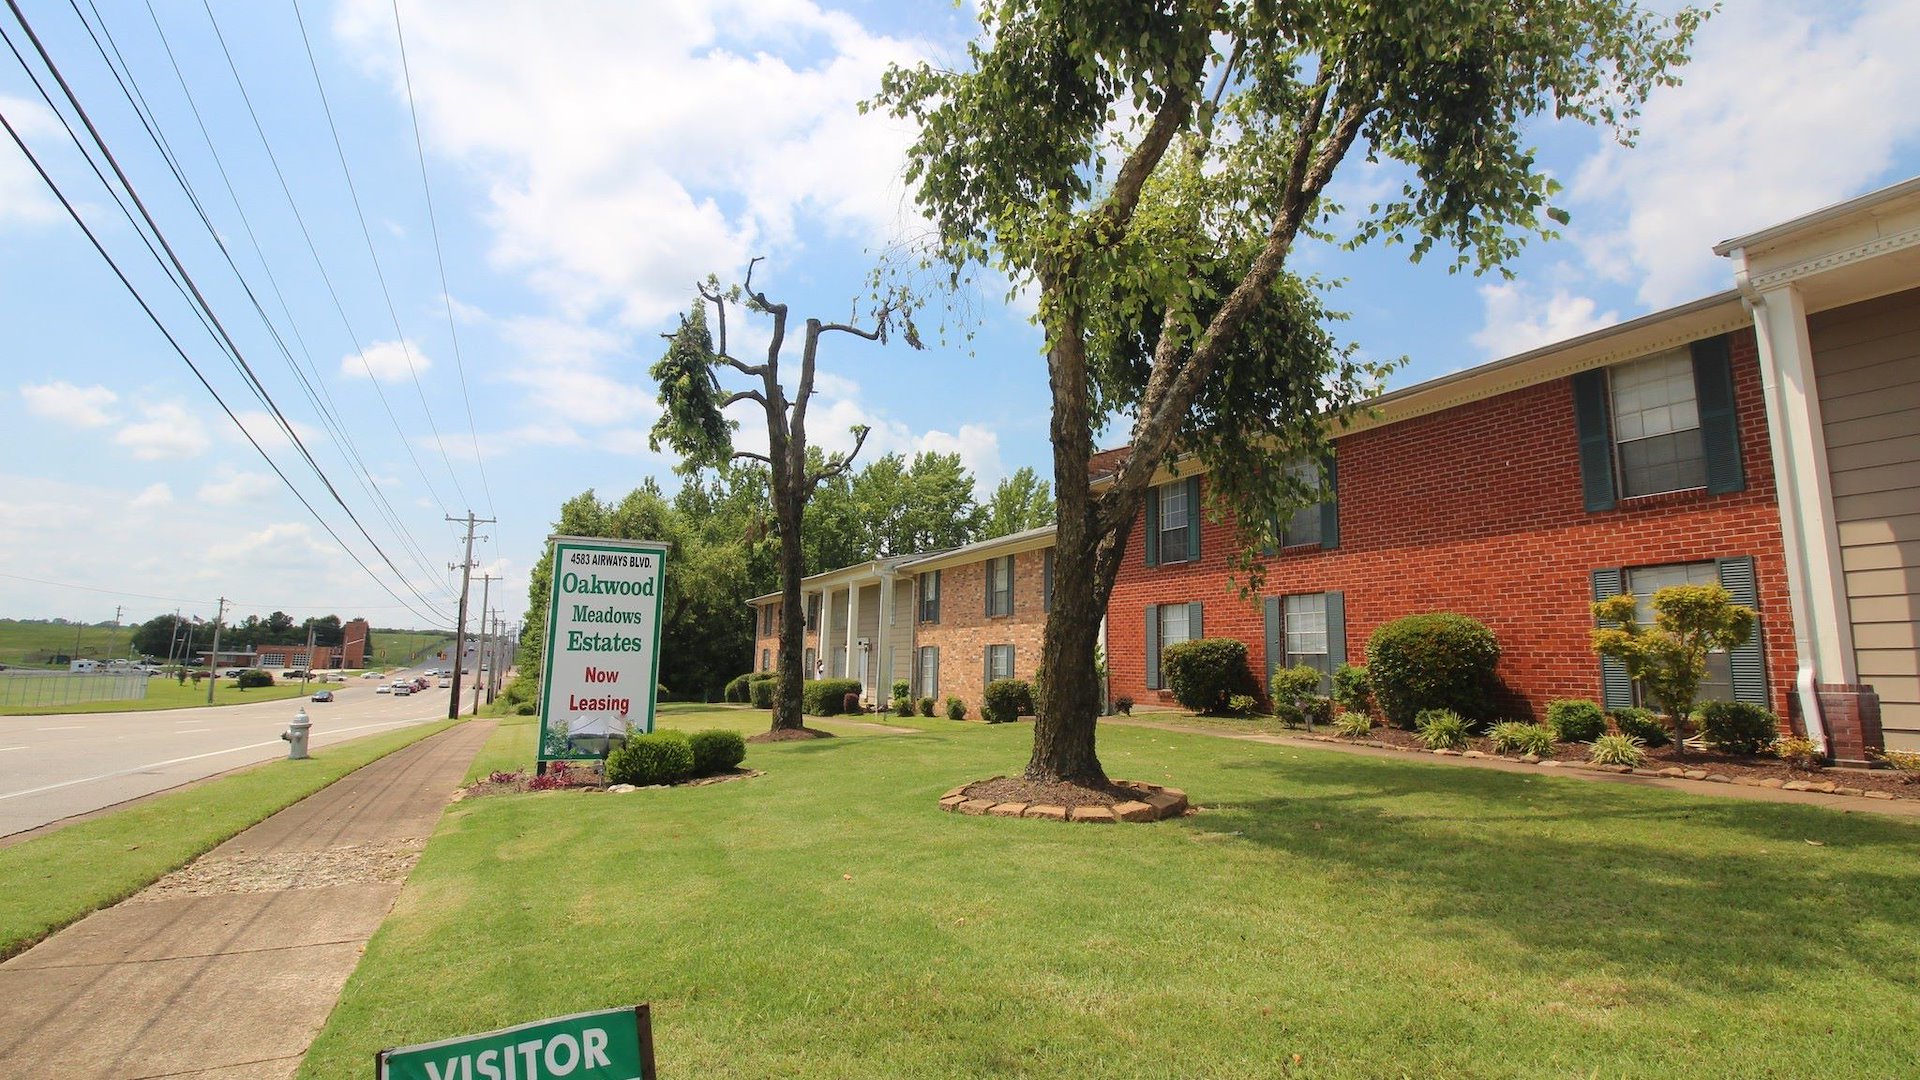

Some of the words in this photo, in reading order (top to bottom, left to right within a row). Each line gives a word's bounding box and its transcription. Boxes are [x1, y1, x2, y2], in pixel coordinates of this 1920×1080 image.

[571, 553, 590, 565] 4583
[592, 554, 628, 567] AIRWAYS
[629, 556, 652, 568] BLVD.
[562, 572, 655, 596] Oakwood
[572, 604, 642, 624] Meadows
[566, 630, 642, 652] Estates
[585, 667, 619, 683] Now
[569, 694, 630, 716] Leasing
